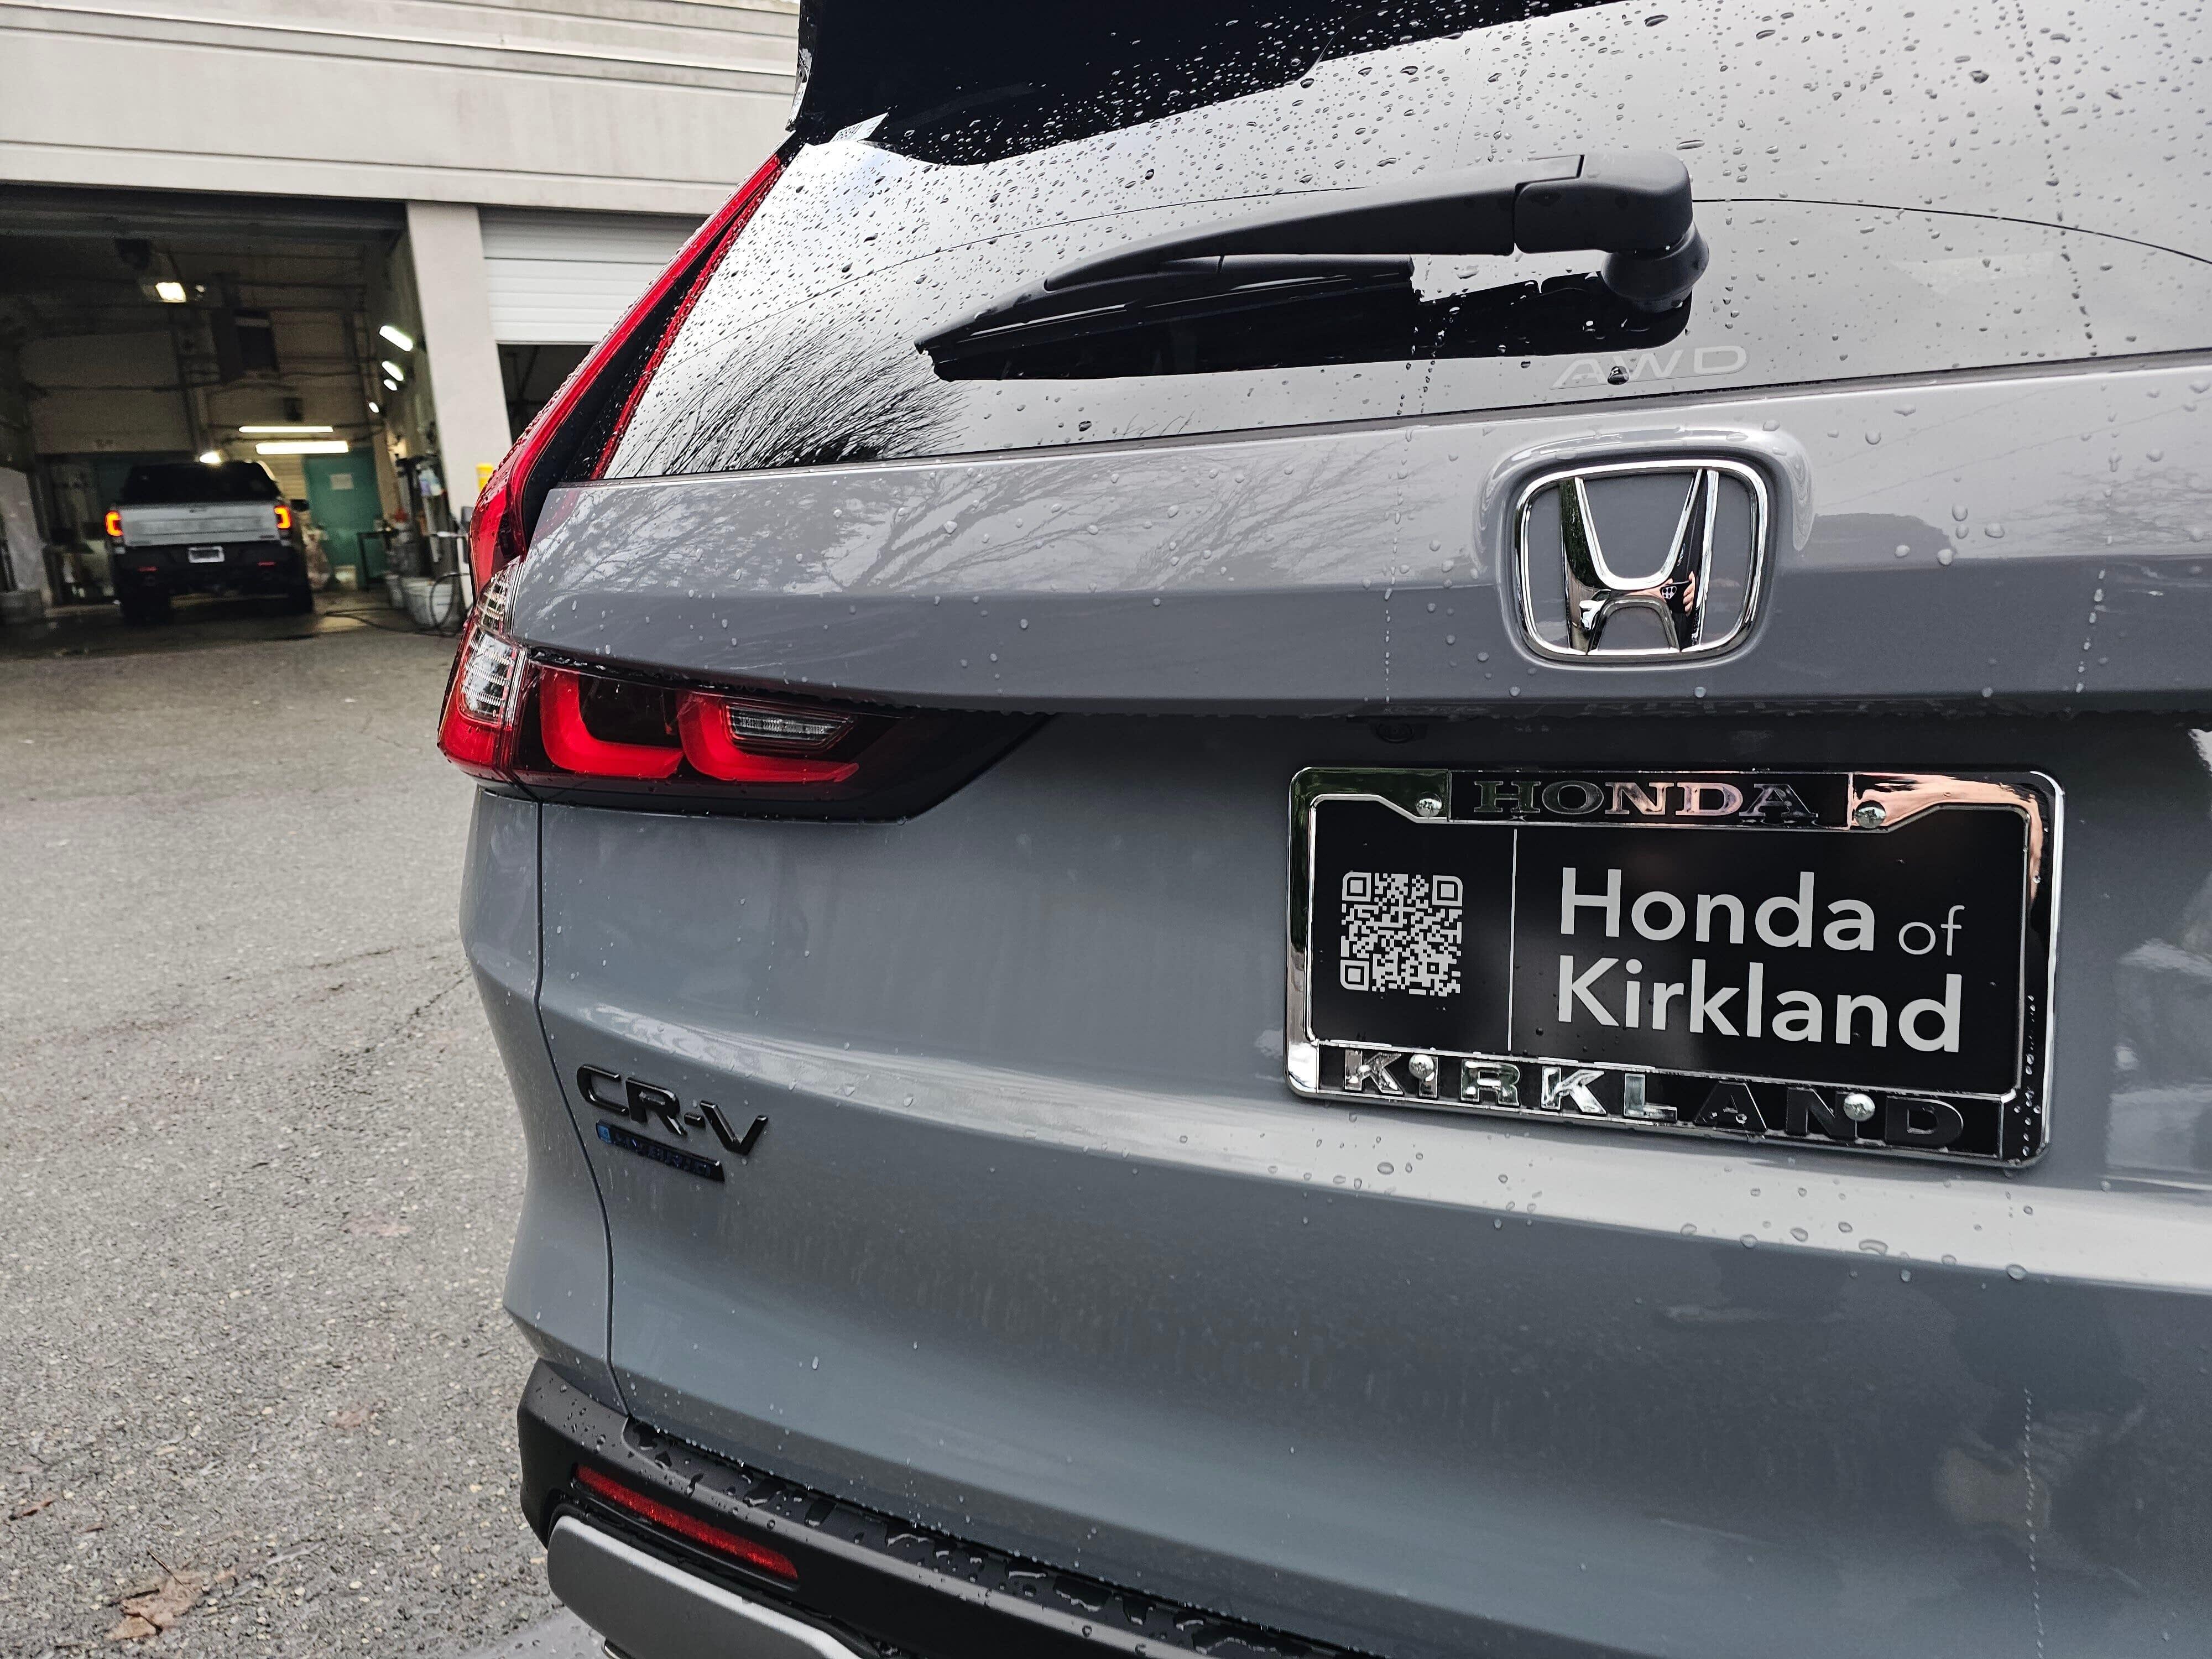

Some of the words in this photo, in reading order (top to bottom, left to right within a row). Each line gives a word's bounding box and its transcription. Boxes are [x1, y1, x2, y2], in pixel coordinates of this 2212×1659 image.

[1551, 346, 1747, 388] AWD
[1474, 780, 1818, 818] HONDA
[1560, 867, 1876, 951] Honda
[1897, 906, 1965, 955] of
[1558, 955, 1961, 1053] Kirkland
[576, 1064, 769, 1155] CR-V
[1344, 1049, 1964, 1145] KIRKLAND
